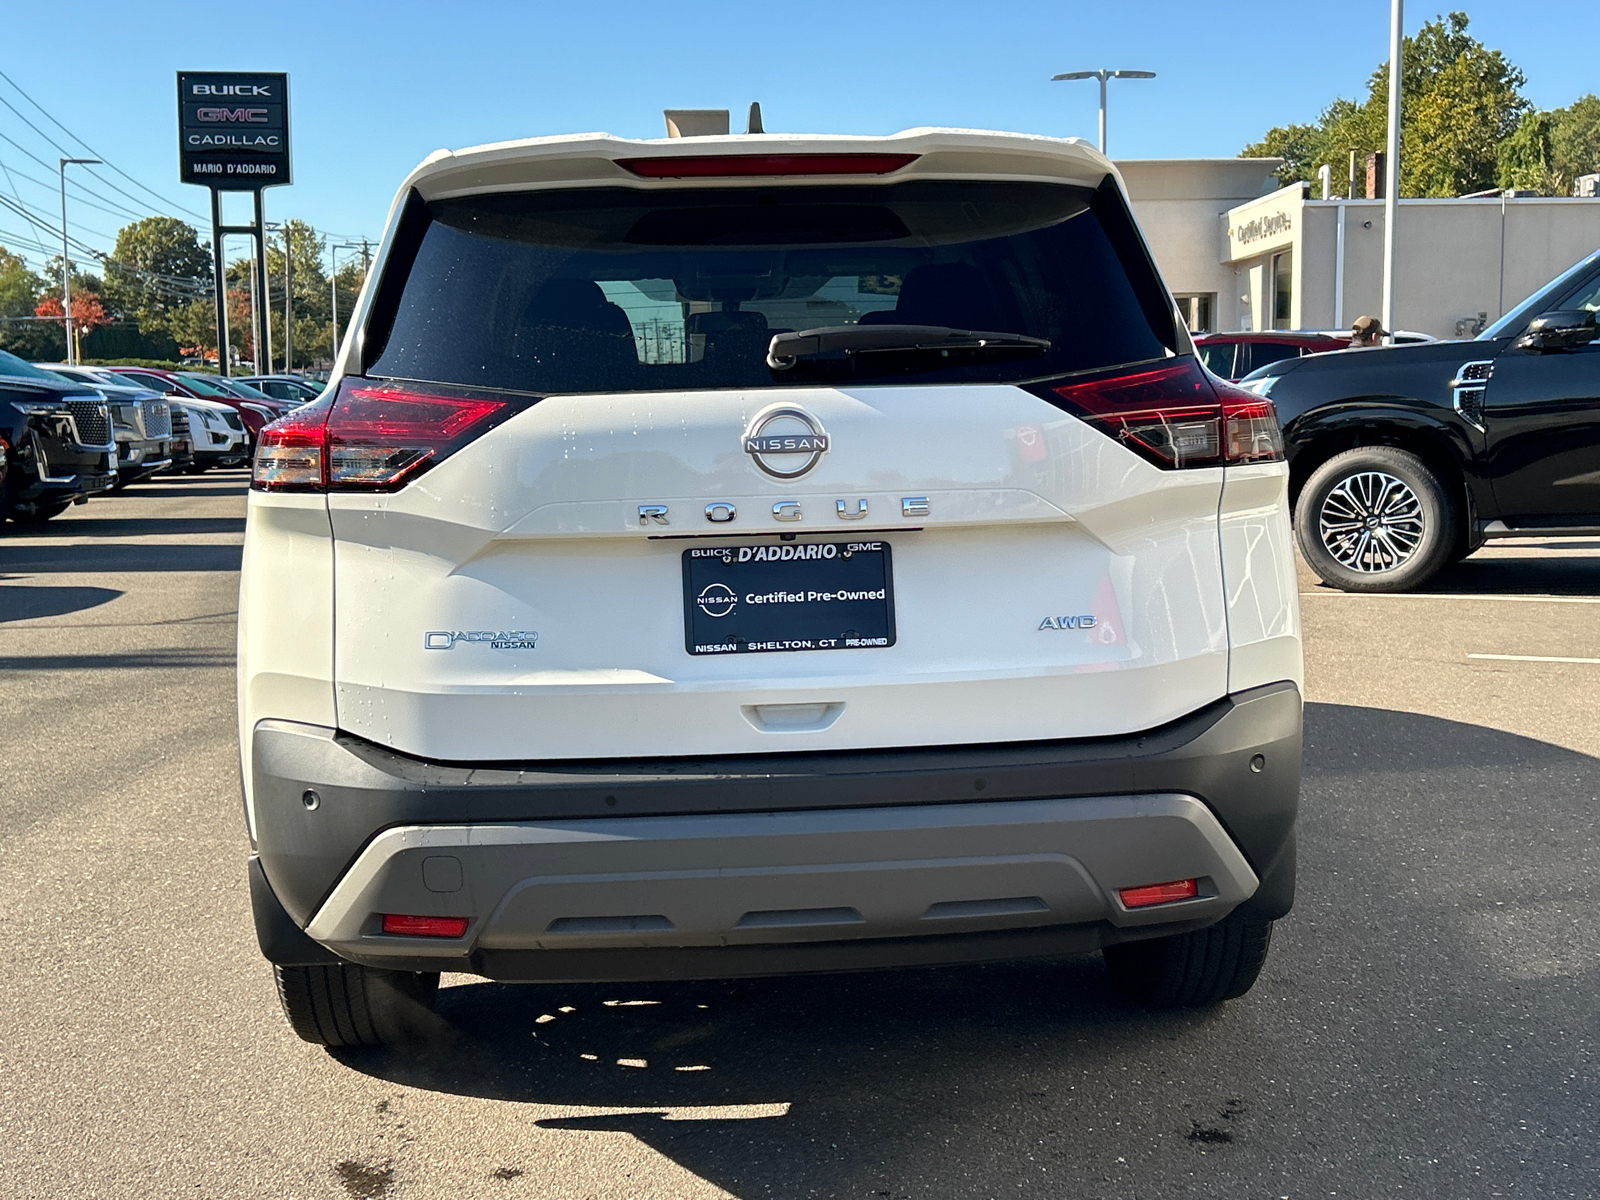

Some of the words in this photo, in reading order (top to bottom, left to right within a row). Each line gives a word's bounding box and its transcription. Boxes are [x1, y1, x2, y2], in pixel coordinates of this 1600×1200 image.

[192, 84, 272, 96] BUICK
[197, 107, 268, 123] GMC
[188, 134, 279, 146] CADILLAC
[193, 163, 223, 174] MARIO
[227, 163, 277, 175] D'ADDARIO
[747, 438, 826, 450] NISSAN
[638, 497, 930, 525] ROGUE
[691, 548, 732, 558] BUICK
[737, 543, 838, 563] D'ADDARIO
[846, 542, 882, 552] GMC
[696, 595, 738, 605] NISSAN
[745, 591, 804, 605] Certified
[807, 588, 886, 602] Pre-Owned
[1038, 614, 1098, 631] AWD
[490, 641, 536, 649] NISSAN
[695, 643, 737, 653] NISSAN
[747, 640, 816, 651] SHELTON,
[818, 639, 838, 648] CT
[845, 637, 888, 647] PRE-OWNED
